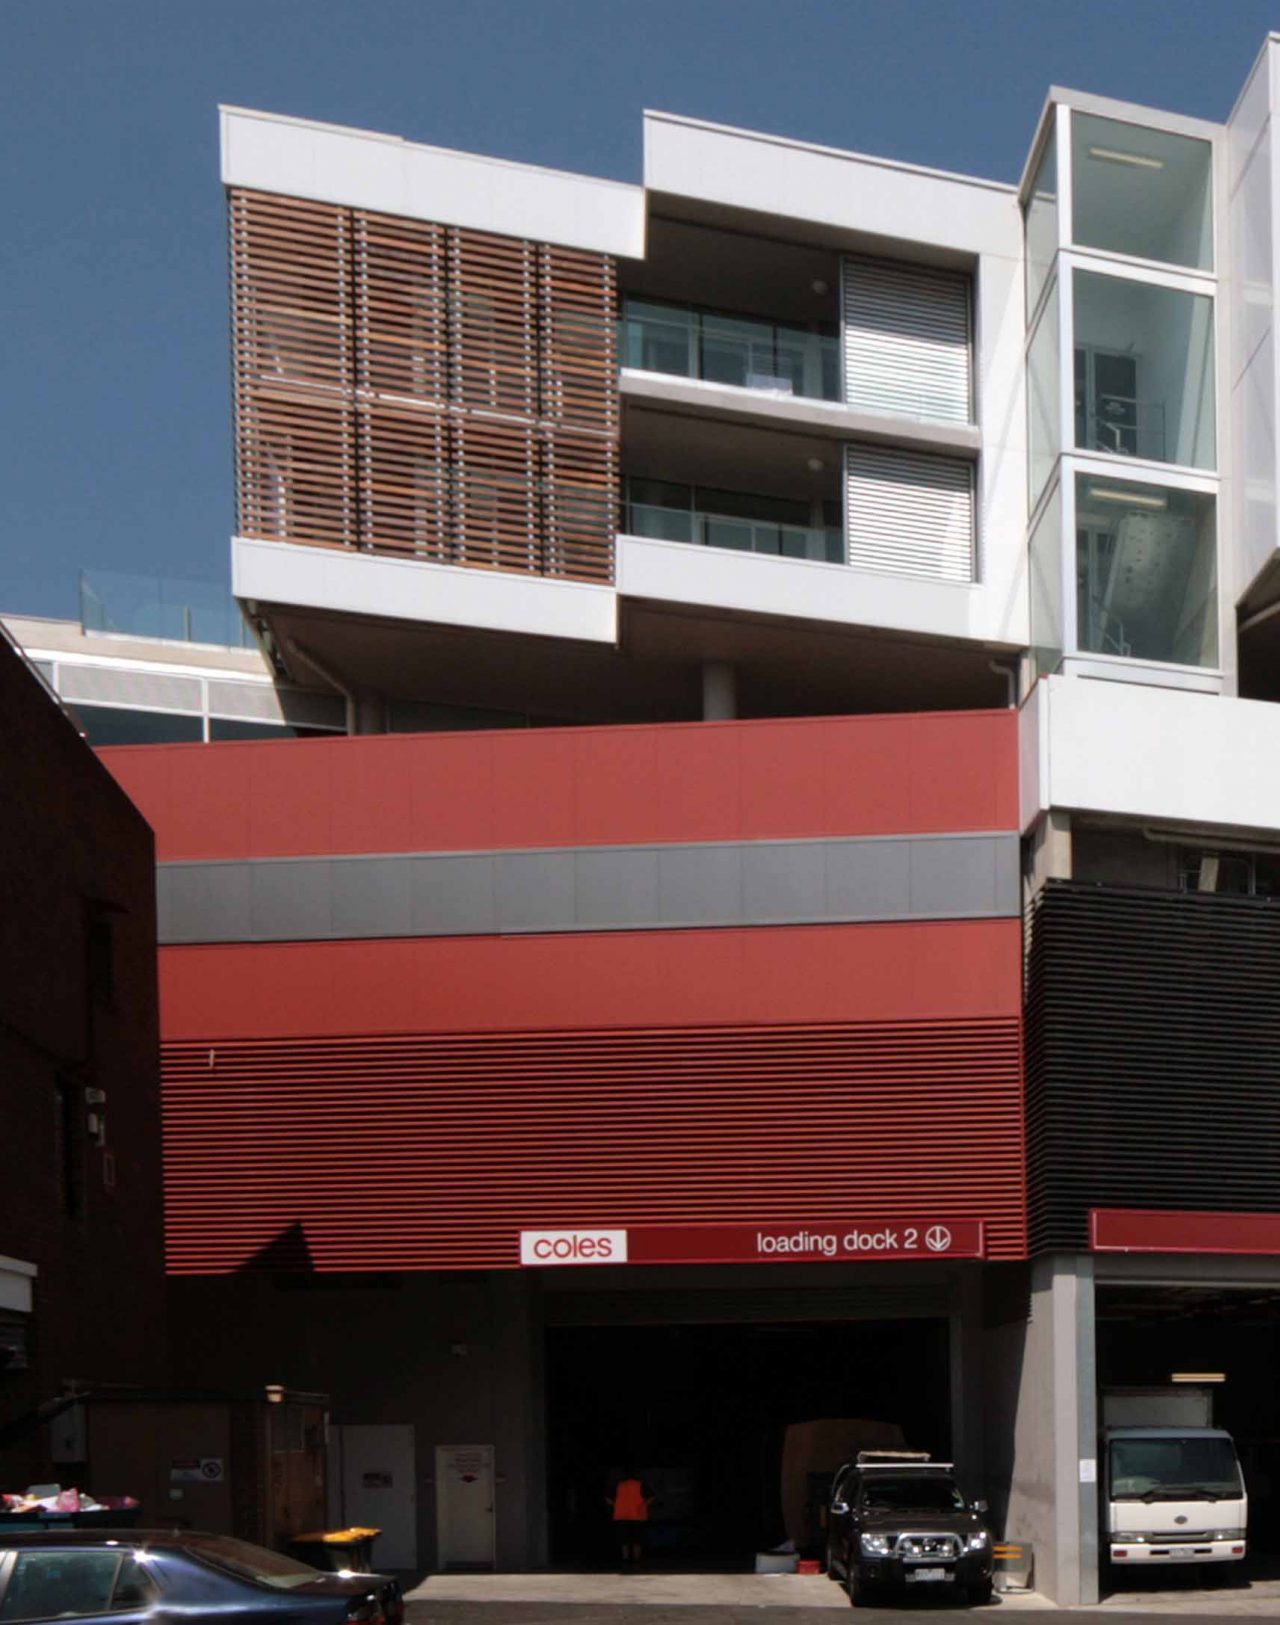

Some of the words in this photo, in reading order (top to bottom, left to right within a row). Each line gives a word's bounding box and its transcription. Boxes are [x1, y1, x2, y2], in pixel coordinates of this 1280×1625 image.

[533, 1234, 613, 1260] coles
[757, 1232, 837, 1256] loading
[843, 1229, 898, 1250] dock
[904, 1228, 918, 1249] 2
